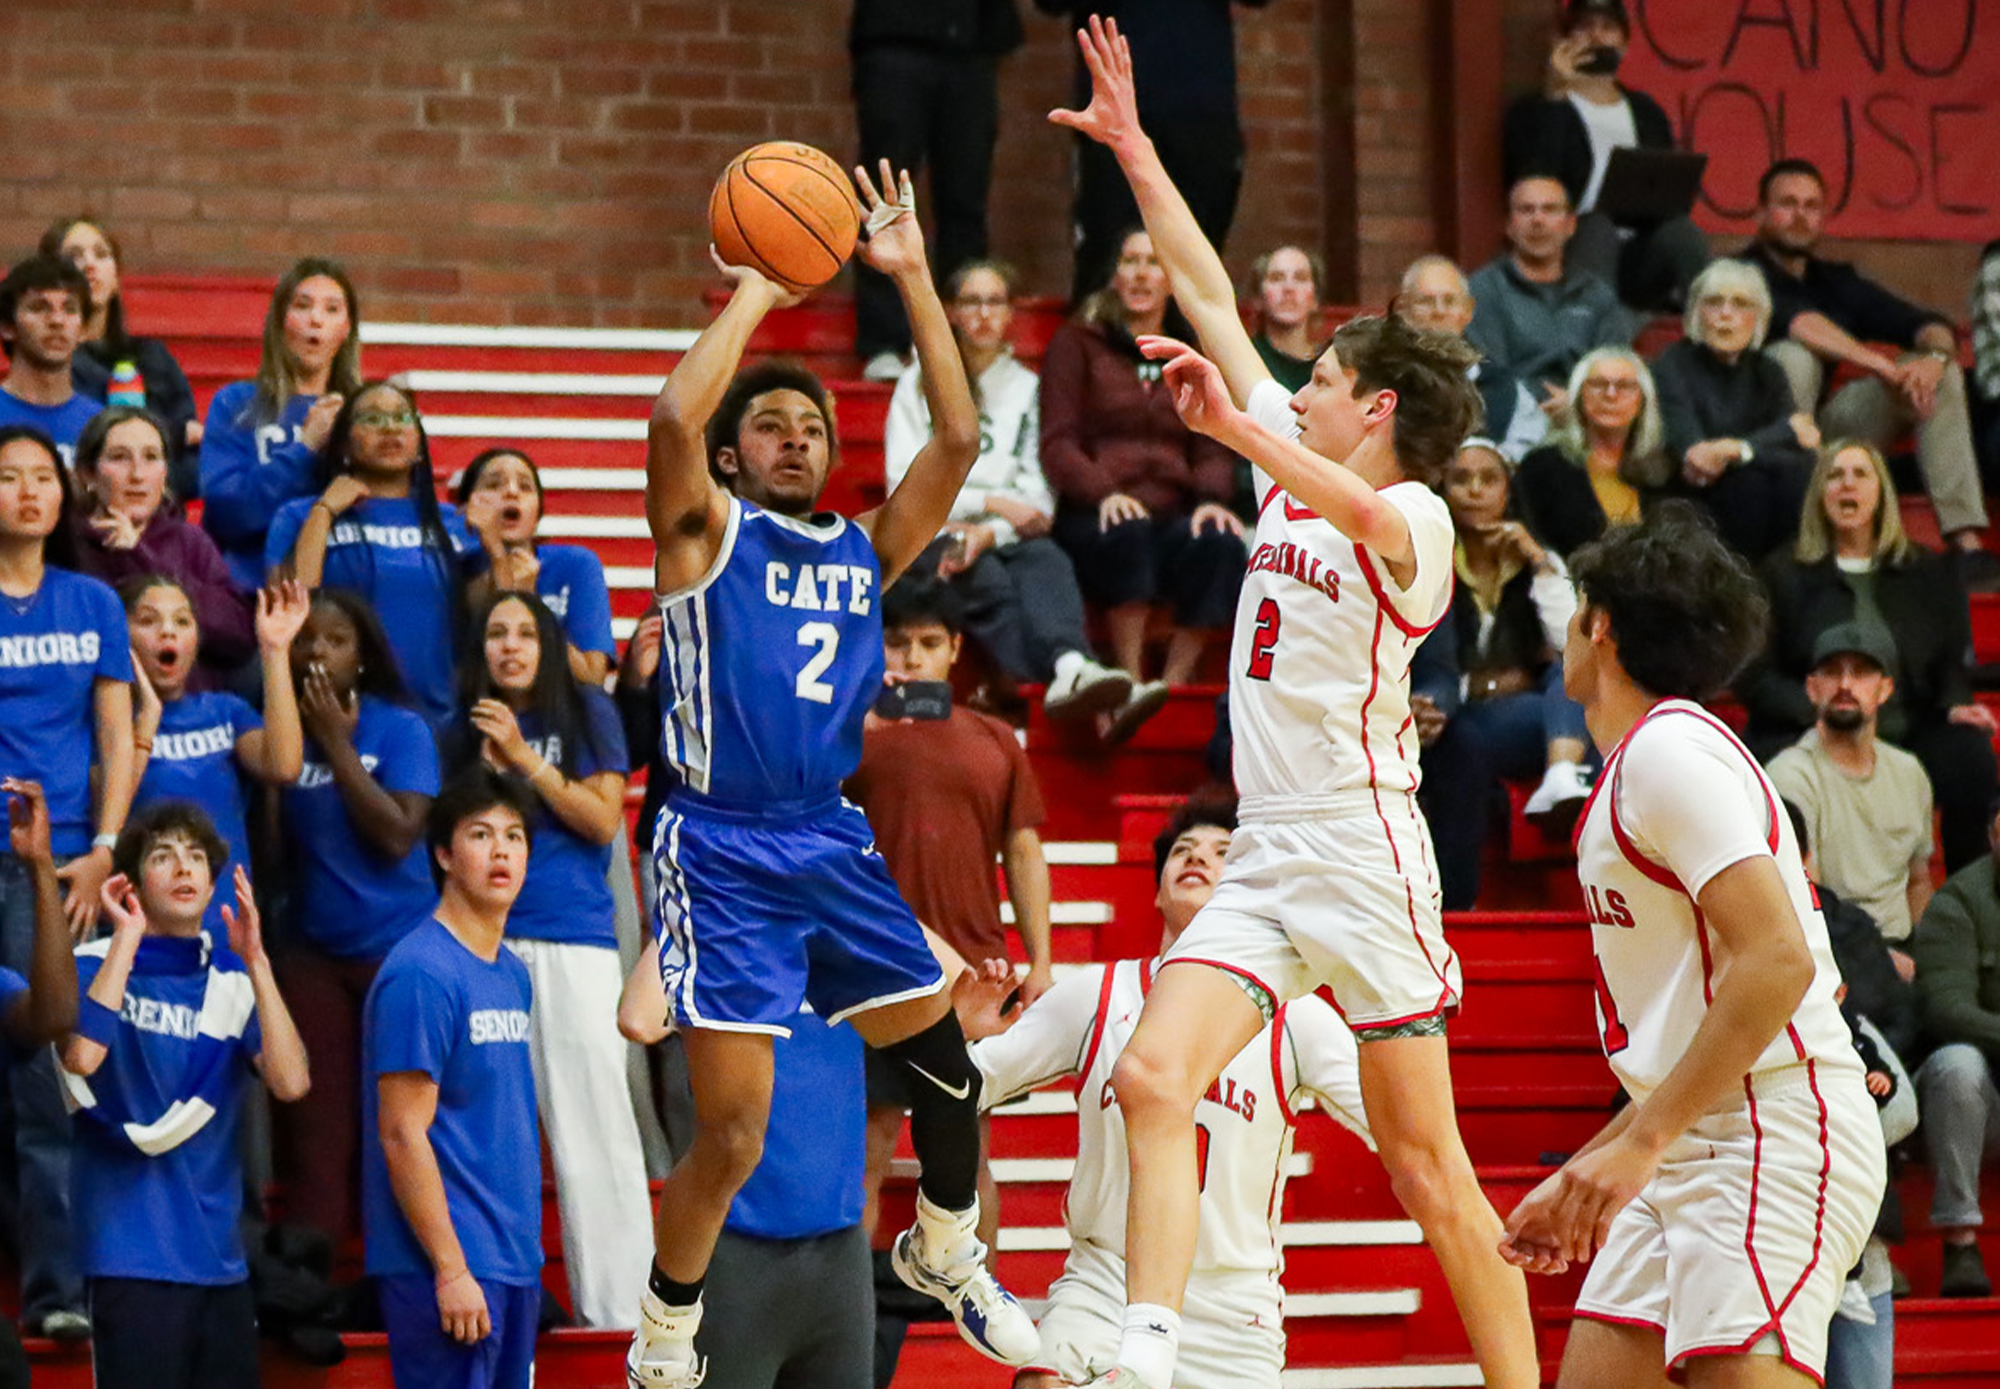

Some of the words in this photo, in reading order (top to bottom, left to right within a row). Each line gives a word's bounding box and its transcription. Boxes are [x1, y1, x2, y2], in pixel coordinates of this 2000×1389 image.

[1679, 80, 1989, 219] OUSE
[765, 560, 873, 617] CATE
[795, 620, 840, 705] 2
[1246, 597, 1281, 681] 2
